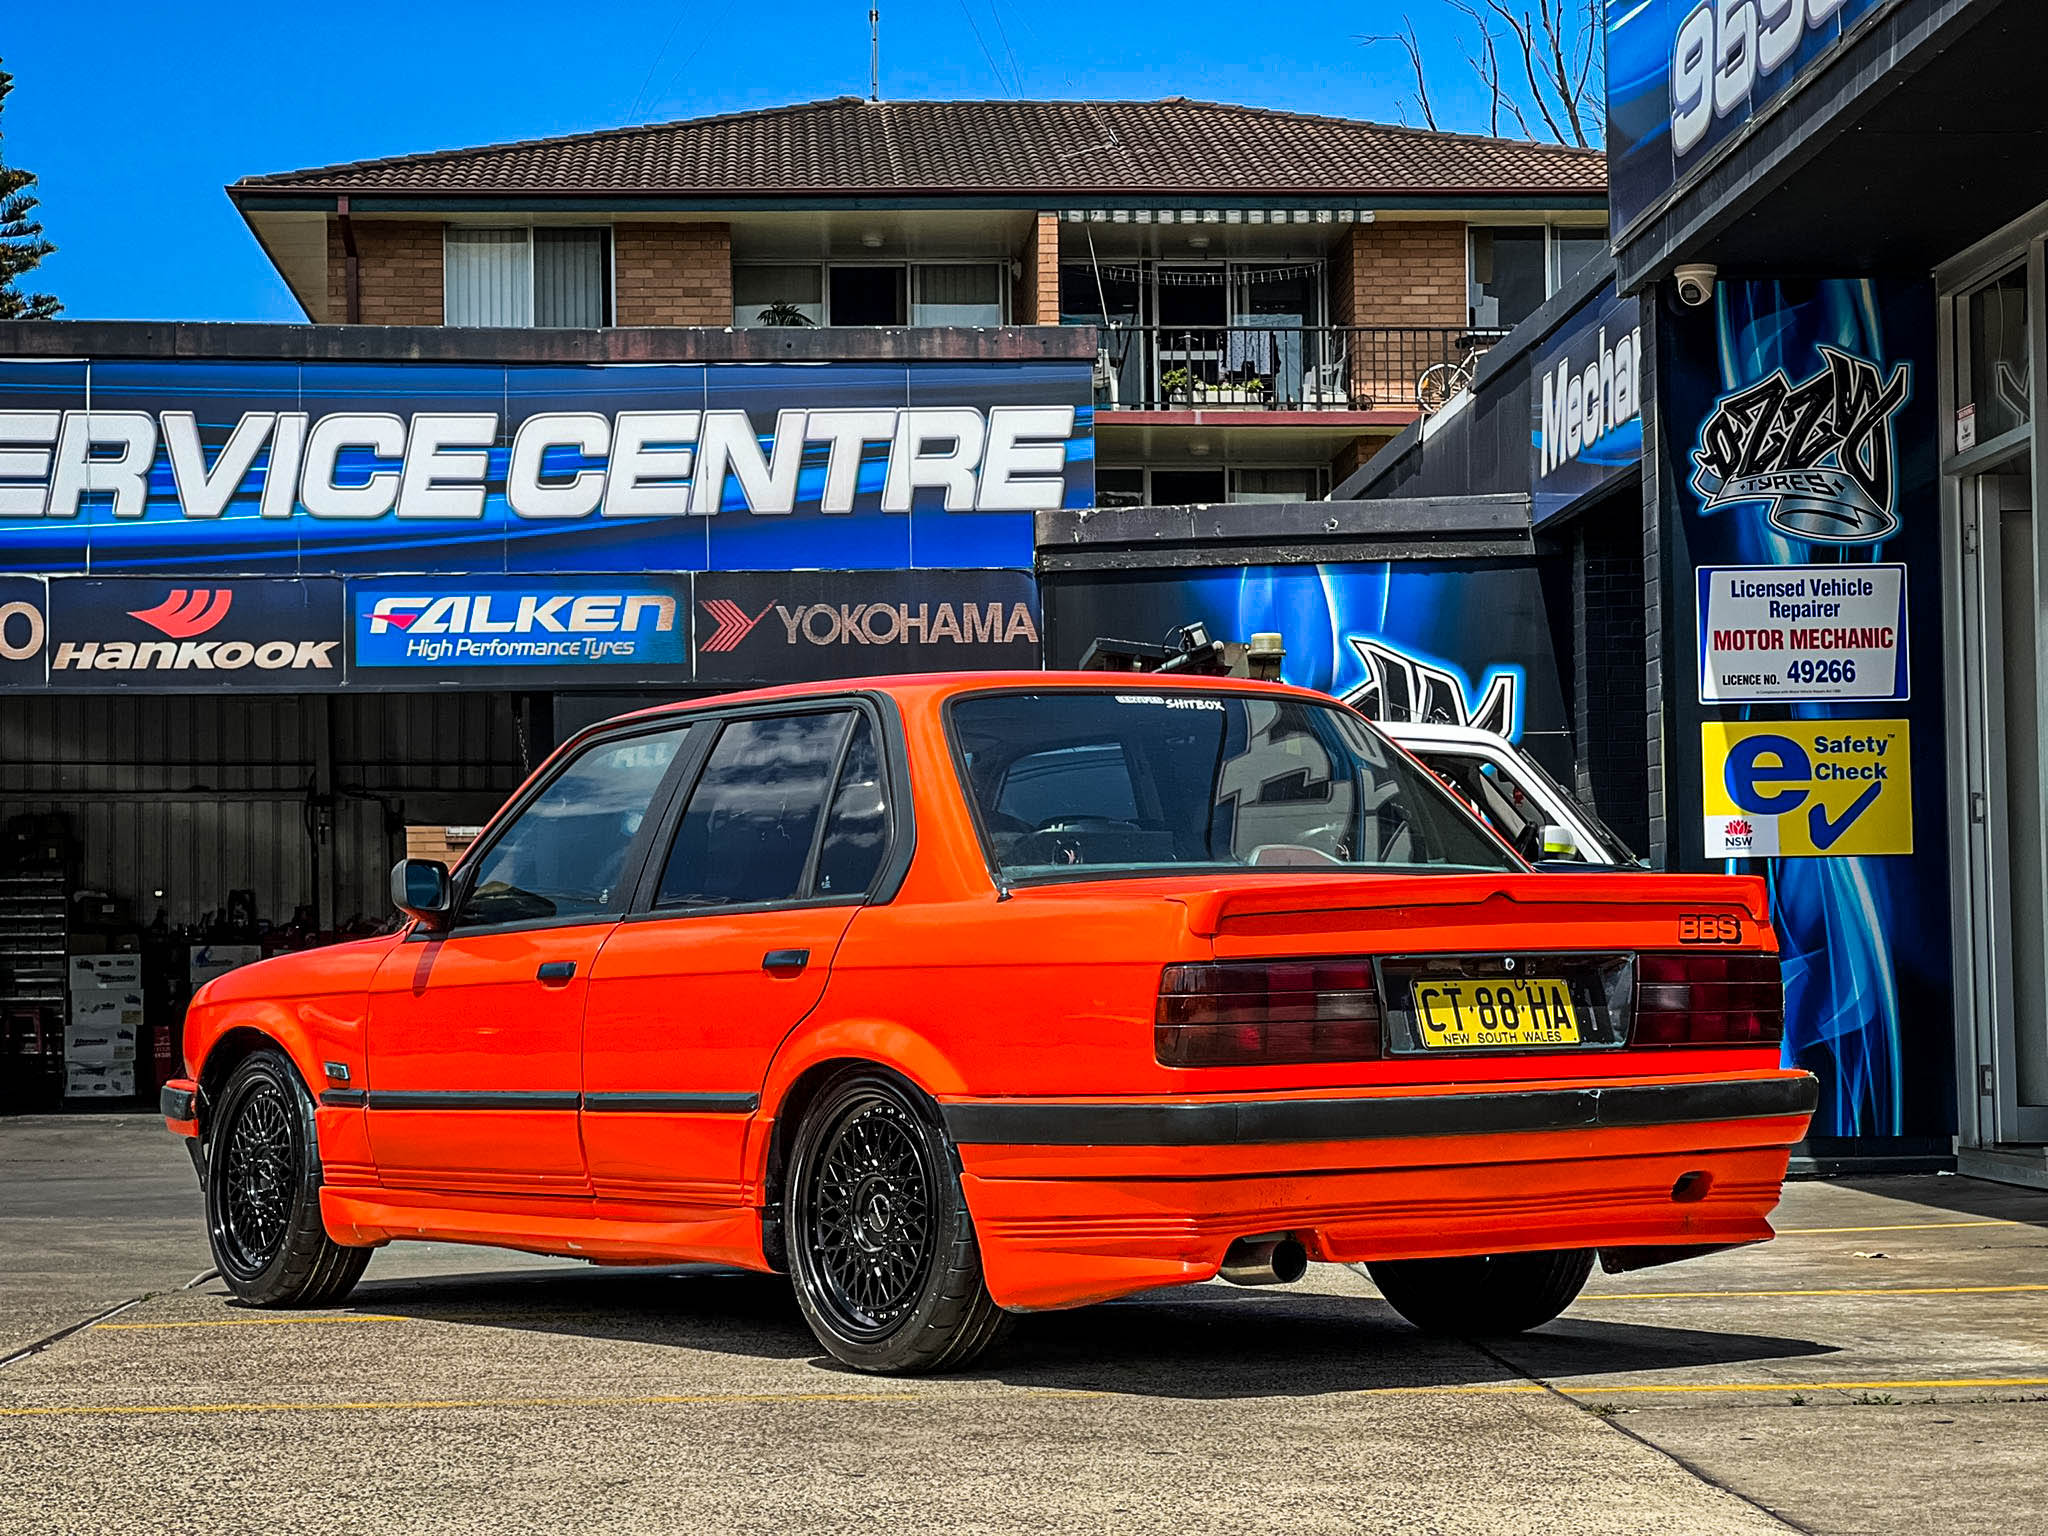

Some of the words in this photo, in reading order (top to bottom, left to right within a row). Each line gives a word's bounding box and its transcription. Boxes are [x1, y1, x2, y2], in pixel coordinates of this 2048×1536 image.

[1673, 0, 1847, 157] 959
[0, 410, 499, 519] ERVICE
[506, 405, 1074, 519] CENTRE
[1746, 472, 1839, 498] TYRES
[1731, 579, 1805, 598] Licensed
[1810, 578, 1873, 597] Vehicle
[370, 596, 676, 633] FALKEN
[1769, 600, 1840, 622] Repairer
[775, 602, 1039, 646] YOKOHAMA
[407, 639, 453, 661] High
[456, 640, 580, 657] Performance
[581, 637, 635, 660] Tyres
[1713, 629, 1784, 651] MOTOR
[1790, 627, 1893, 649] MECHANIC
[1722, 674, 1761, 686] LICENCE
[1763, 674, 1780, 685] NO.
[1787, 659, 1856, 683] 49266
[1165, 698, 1226, 712] SHITBOX
[1814, 735, 1888, 756] Safety
[1724, 734, 1811, 815] e
[1815, 762, 1888, 780] Check
[1725, 836, 1753, 847] NSW
[1679, 913, 1742, 944] BBS
[1443, 1034, 1470, 1045] NEW
[1478, 1032, 1517, 1044] SOUTH
[1523, 1031, 1562, 1043] WALES
